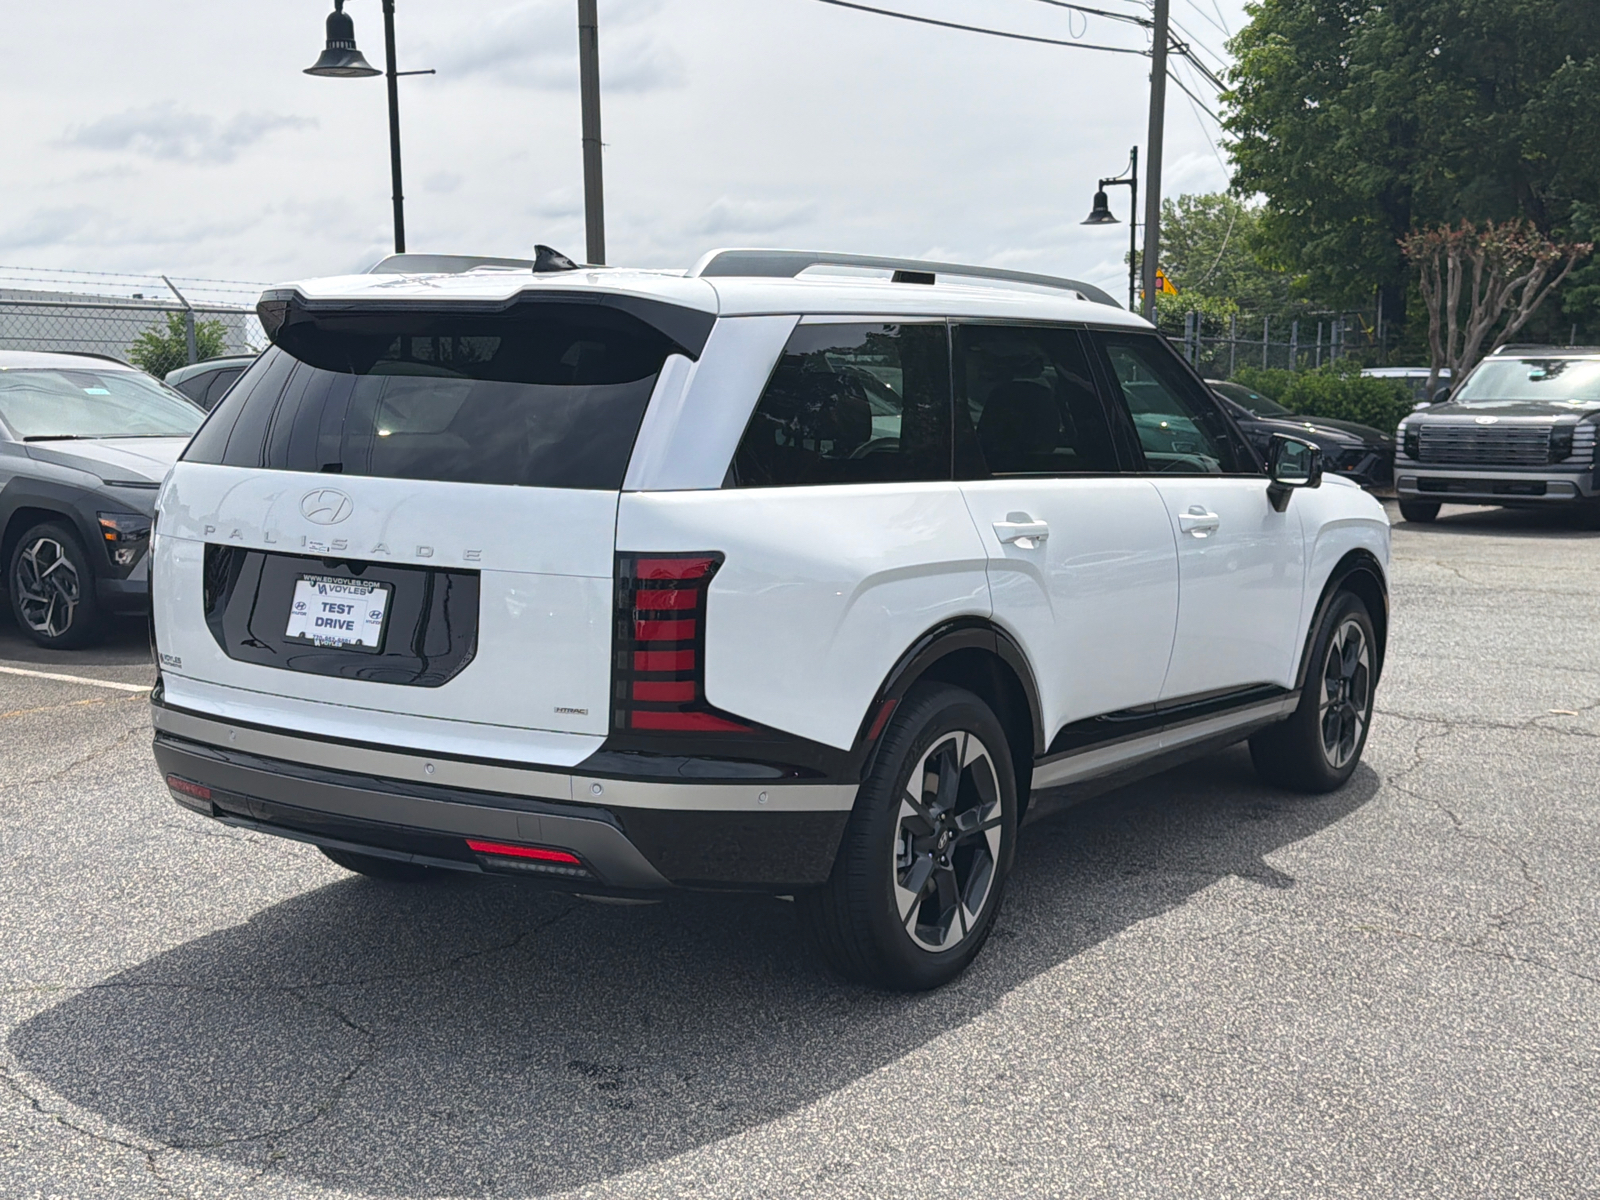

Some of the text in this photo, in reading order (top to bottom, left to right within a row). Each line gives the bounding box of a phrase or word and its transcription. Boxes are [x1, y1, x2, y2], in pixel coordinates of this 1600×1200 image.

[203, 525, 483, 562] PALISADE
[329, 585, 367, 596] VOYLES
[321, 602, 355, 615] TEST
[315, 617, 355, 631] DRIVE
[554, 706, 588, 716] HTRAC
